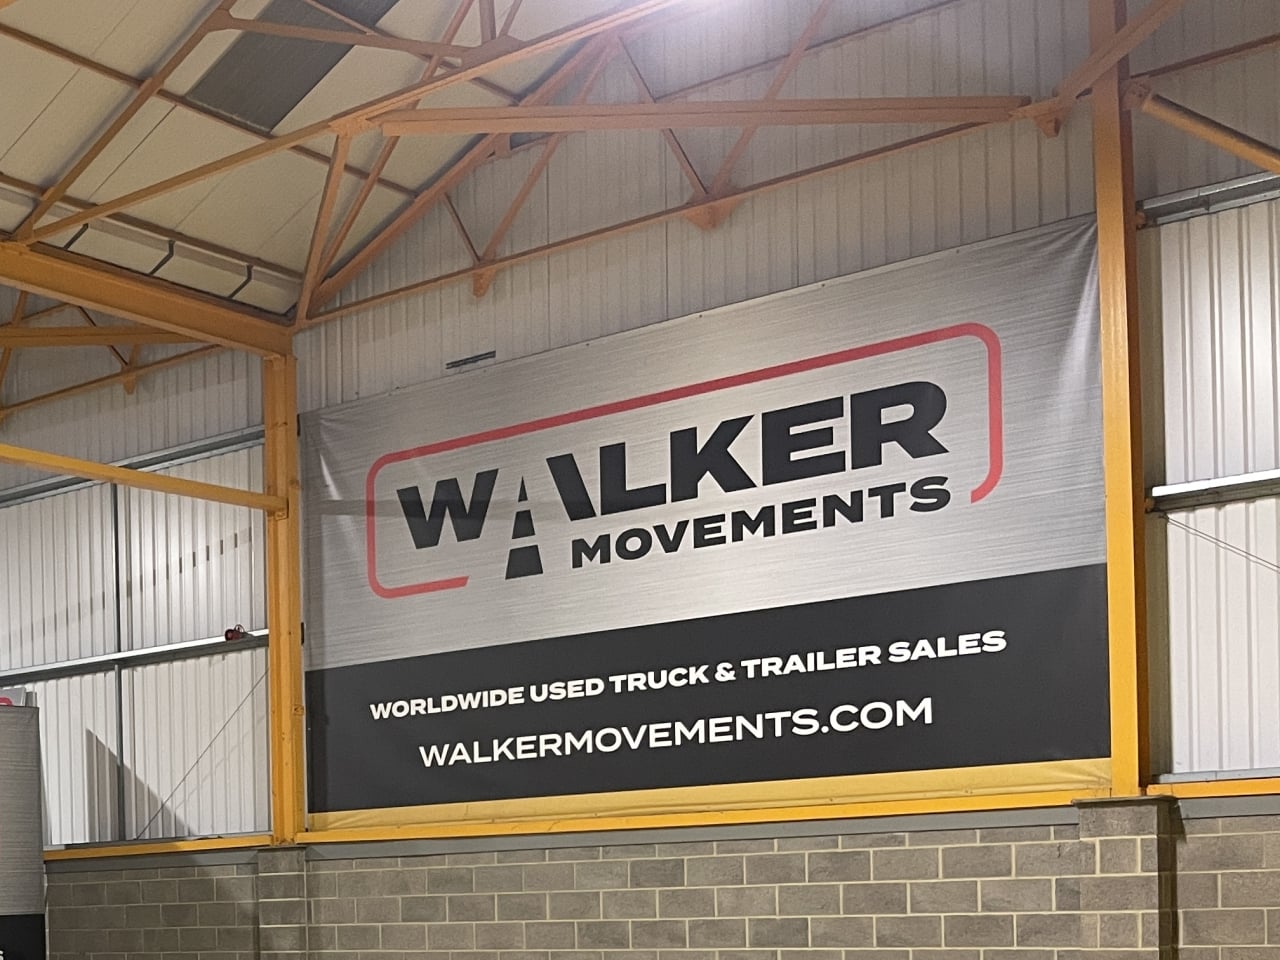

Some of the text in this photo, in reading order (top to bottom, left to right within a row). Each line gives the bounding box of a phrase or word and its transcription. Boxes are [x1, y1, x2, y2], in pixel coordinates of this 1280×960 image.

[396, 381, 949, 580] WALKER
[572, 476, 951, 569] MOVEMENTS
[369, 630, 1008, 720] WORLDWIDE USED TRUCK & TRAILER SALES
[419, 697, 934, 768] WALKERMOVEMENTS.COM
